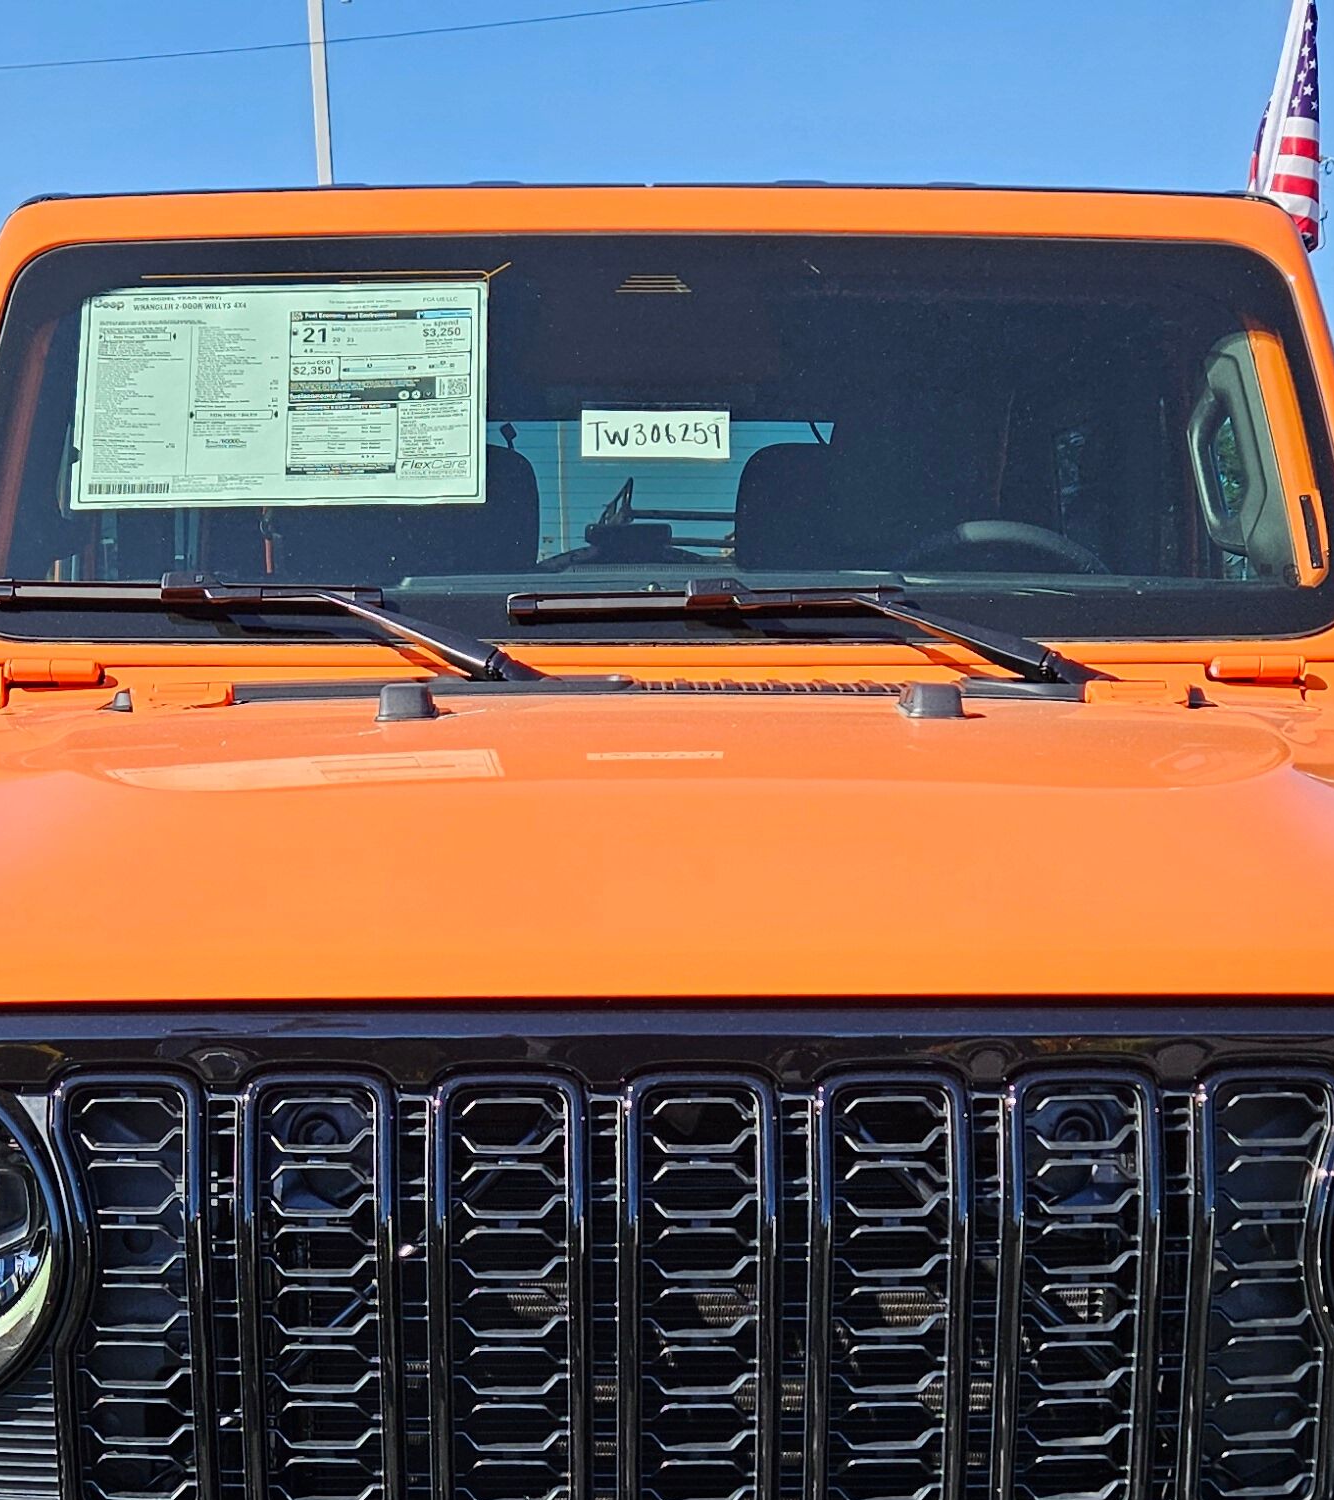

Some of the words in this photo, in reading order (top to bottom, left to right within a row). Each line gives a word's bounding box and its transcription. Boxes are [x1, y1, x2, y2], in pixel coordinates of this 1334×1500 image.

[303, 327, 327, 343] 21
[422, 327, 461, 338] $3,250
[292, 366, 332, 376] $2,350
[586, 420, 723, 452] TW306259
[401, 459, 467, 470] FlexCare
